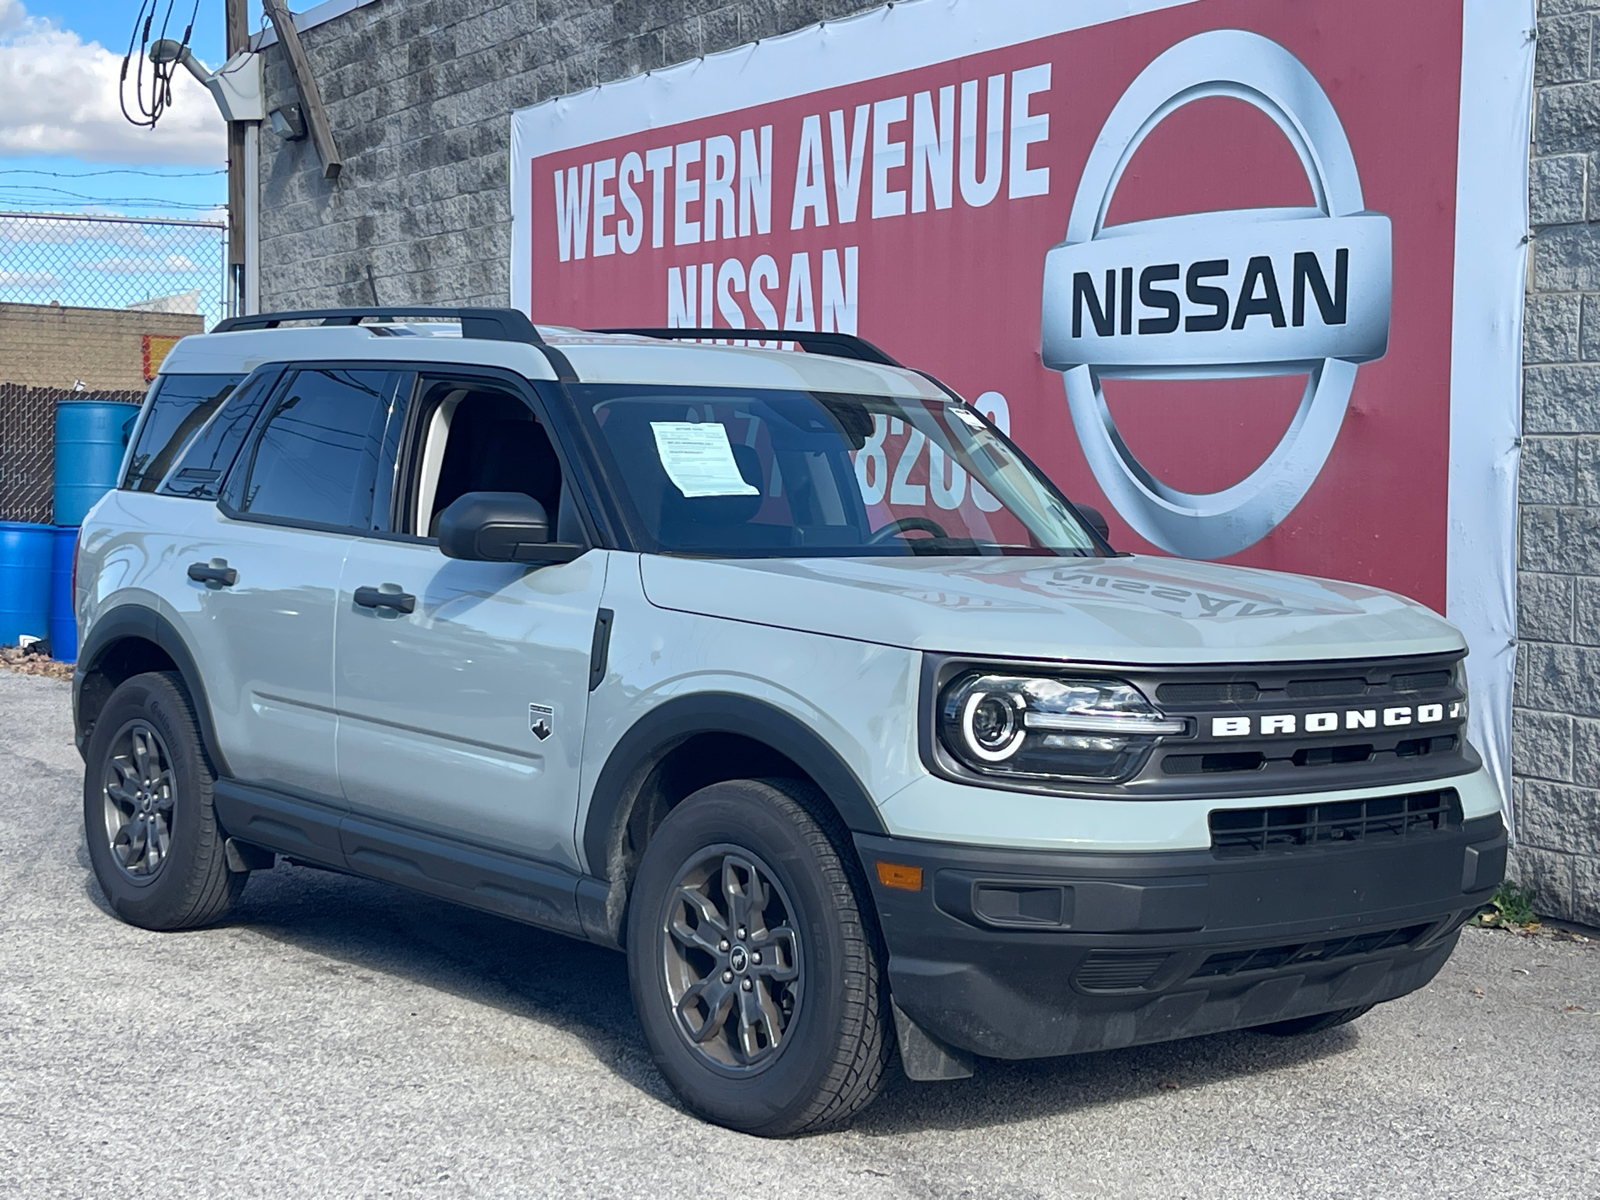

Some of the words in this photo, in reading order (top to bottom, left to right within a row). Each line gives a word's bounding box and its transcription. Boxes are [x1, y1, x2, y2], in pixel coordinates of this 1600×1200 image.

[554, 124, 773, 262] WESTERN
[790, 62, 1052, 231] AVENUE
[668, 246, 859, 352] NISSAN
[1071, 247, 1349, 339] NISSAN
[1211, 703, 1443, 737] BRONCO
